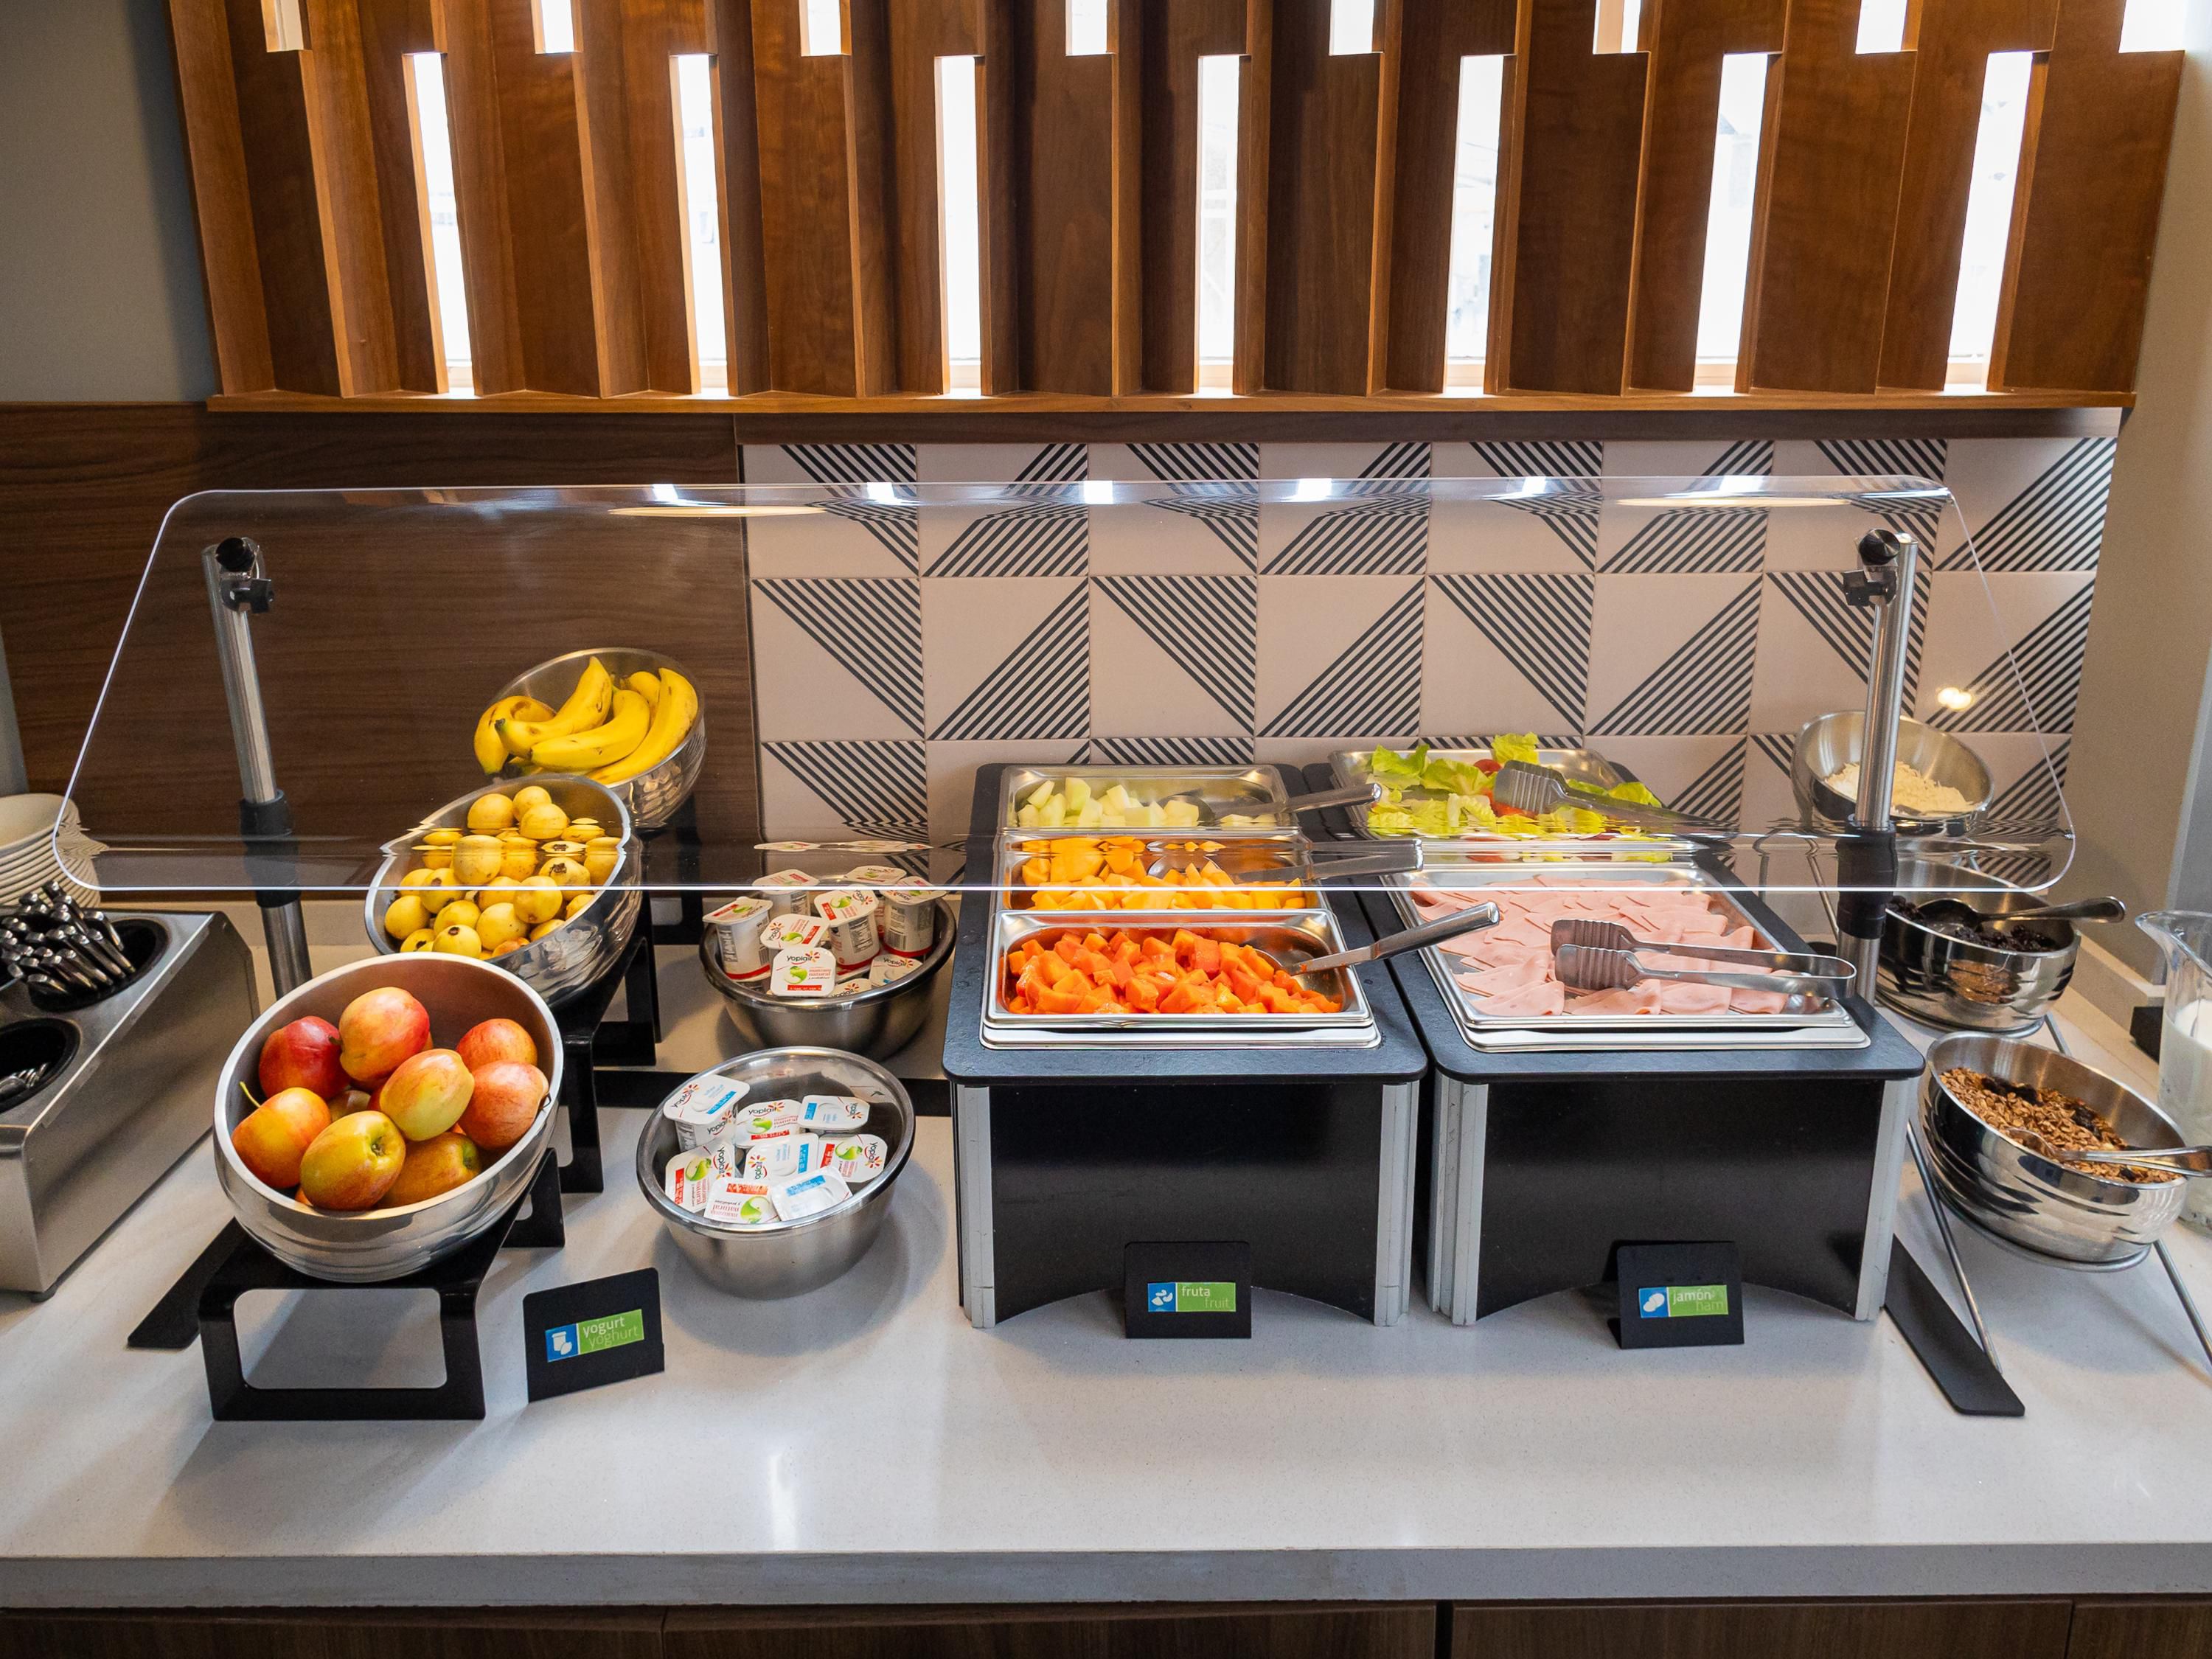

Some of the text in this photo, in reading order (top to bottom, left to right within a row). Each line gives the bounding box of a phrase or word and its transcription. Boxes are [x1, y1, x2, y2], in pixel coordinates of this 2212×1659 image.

[1182, 1286, 1211, 1296] fruta
[1672, 1288, 1711, 1305] jamón
[1204, 1298, 1230, 1308] fruit
[1697, 1299, 1723, 1311] ham
[583, 1317, 625, 1338] yogurt
[589, 1325, 639, 1349] yoghurt
